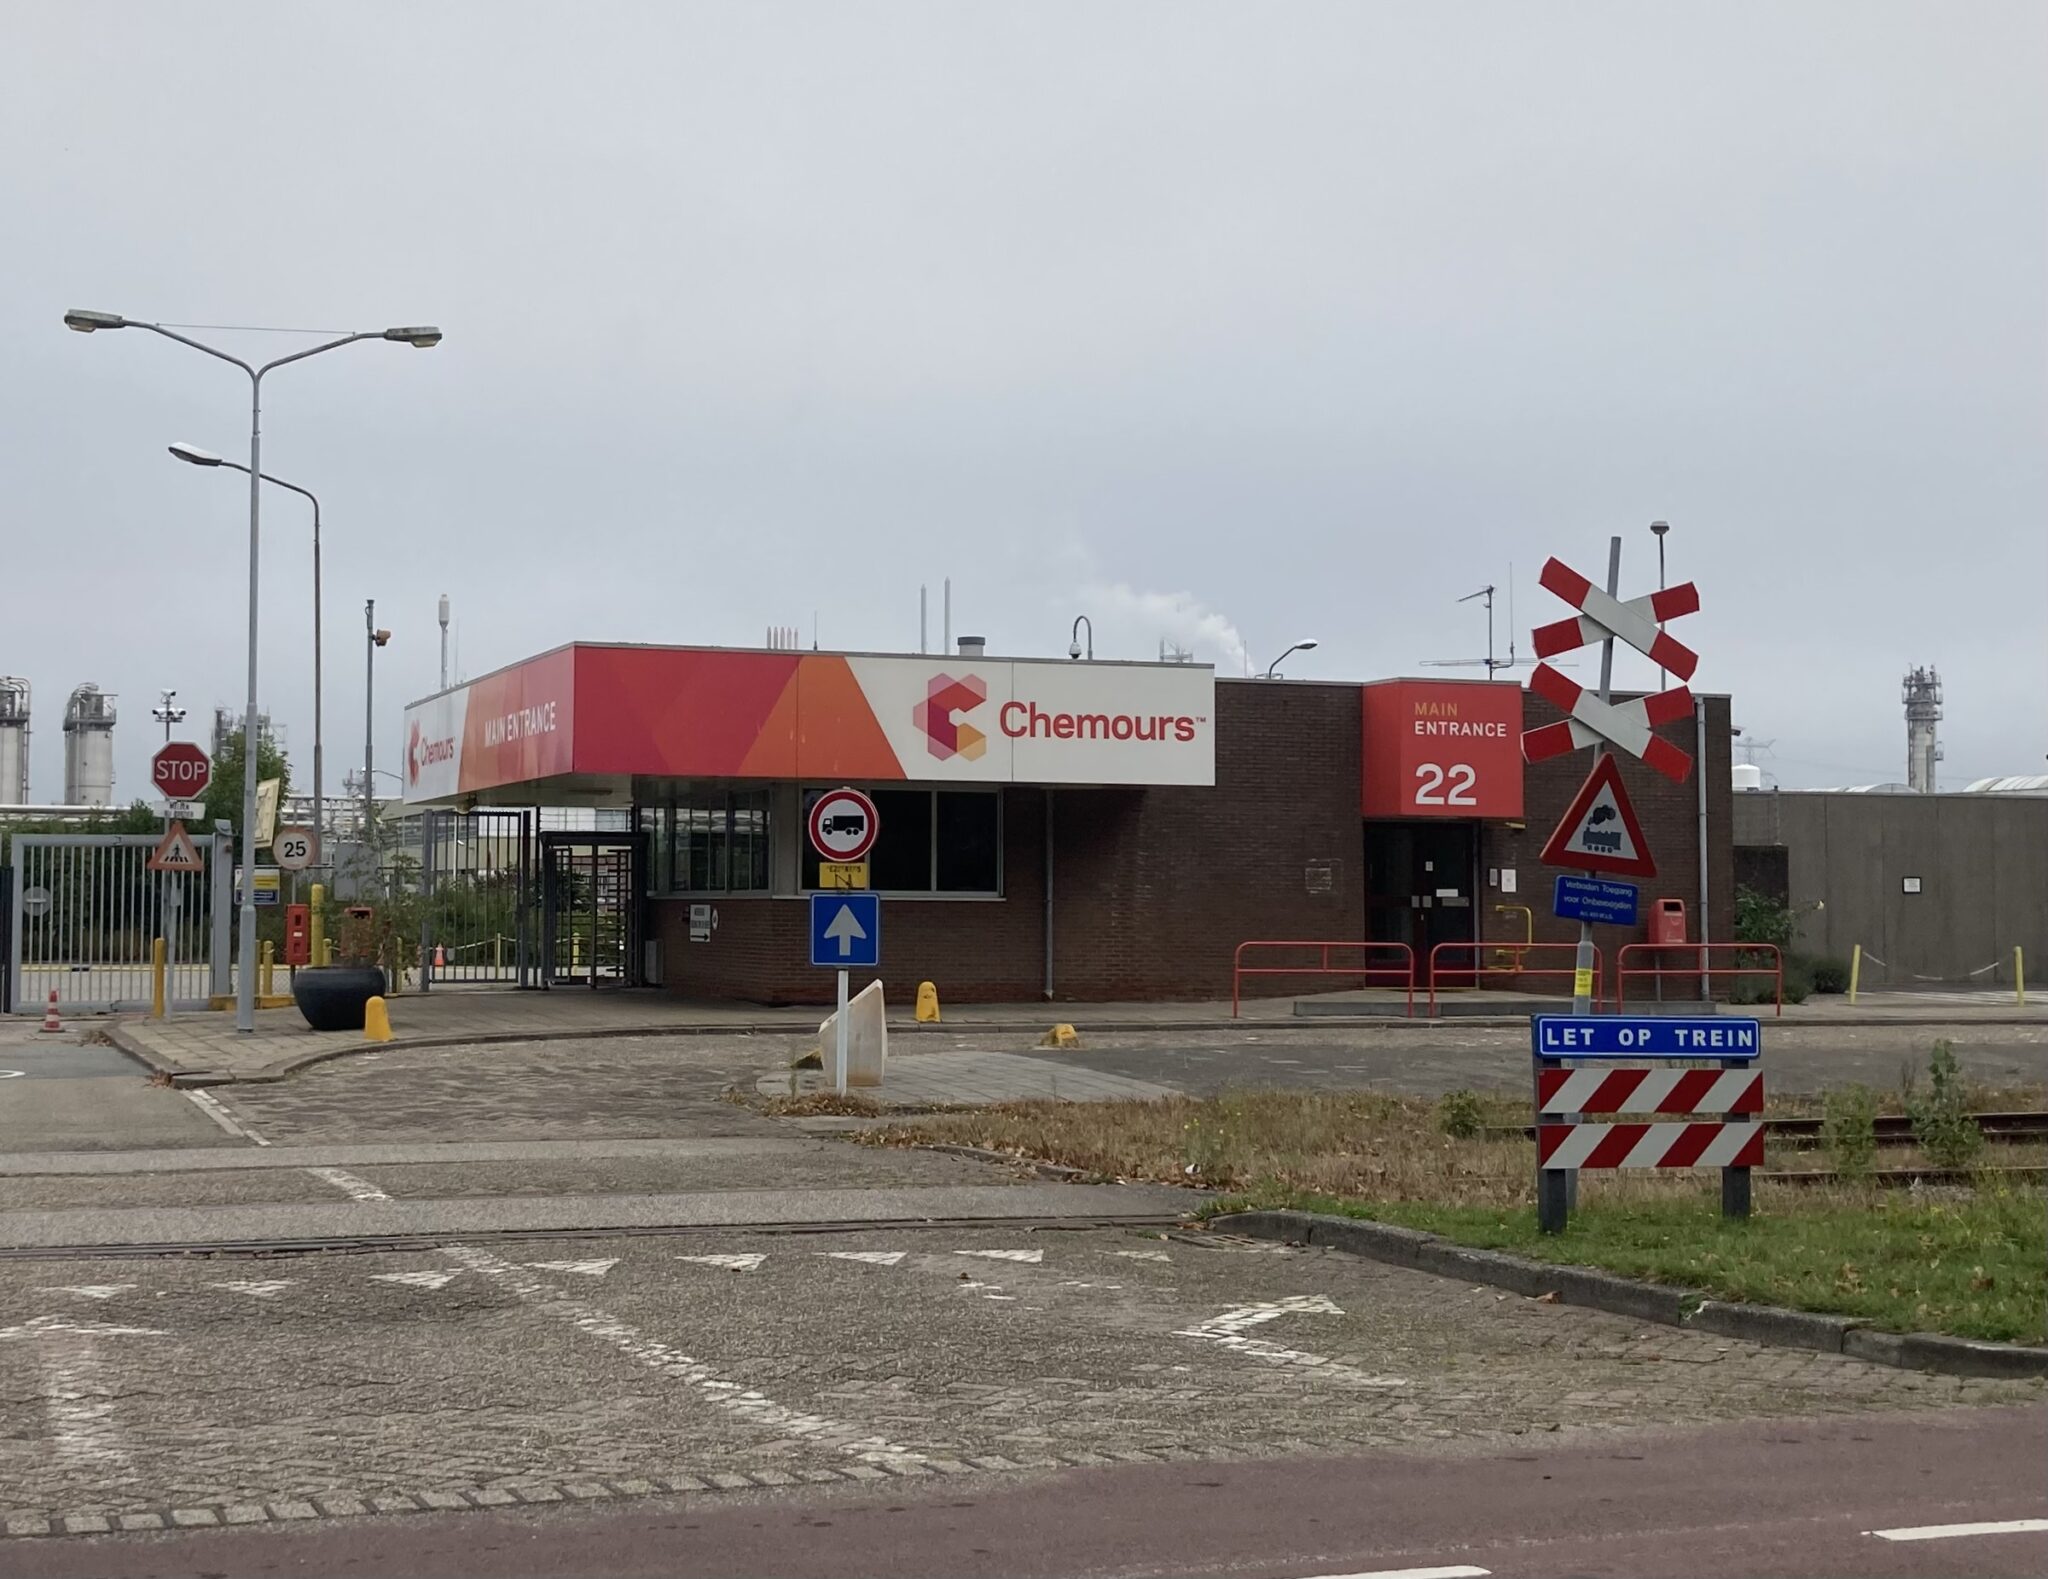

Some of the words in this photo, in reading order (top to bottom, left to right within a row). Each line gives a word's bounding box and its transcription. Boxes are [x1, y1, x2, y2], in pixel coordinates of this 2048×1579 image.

[1414, 702, 1458, 717] MAIN
[484, 715, 506, 747] MAIN
[507, 701, 556, 742] ENTRANCE
[1414, 720, 1507, 738] ENTRANCE
[156, 760, 207, 780] STOP
[1415, 762, 1477, 806] 22
[283, 841, 307, 858] 25
[1546, 1028, 1594, 1046] LET
[1618, 1028, 1652, 1046] OP
[1674, 1029, 1753, 1047] TREIN
